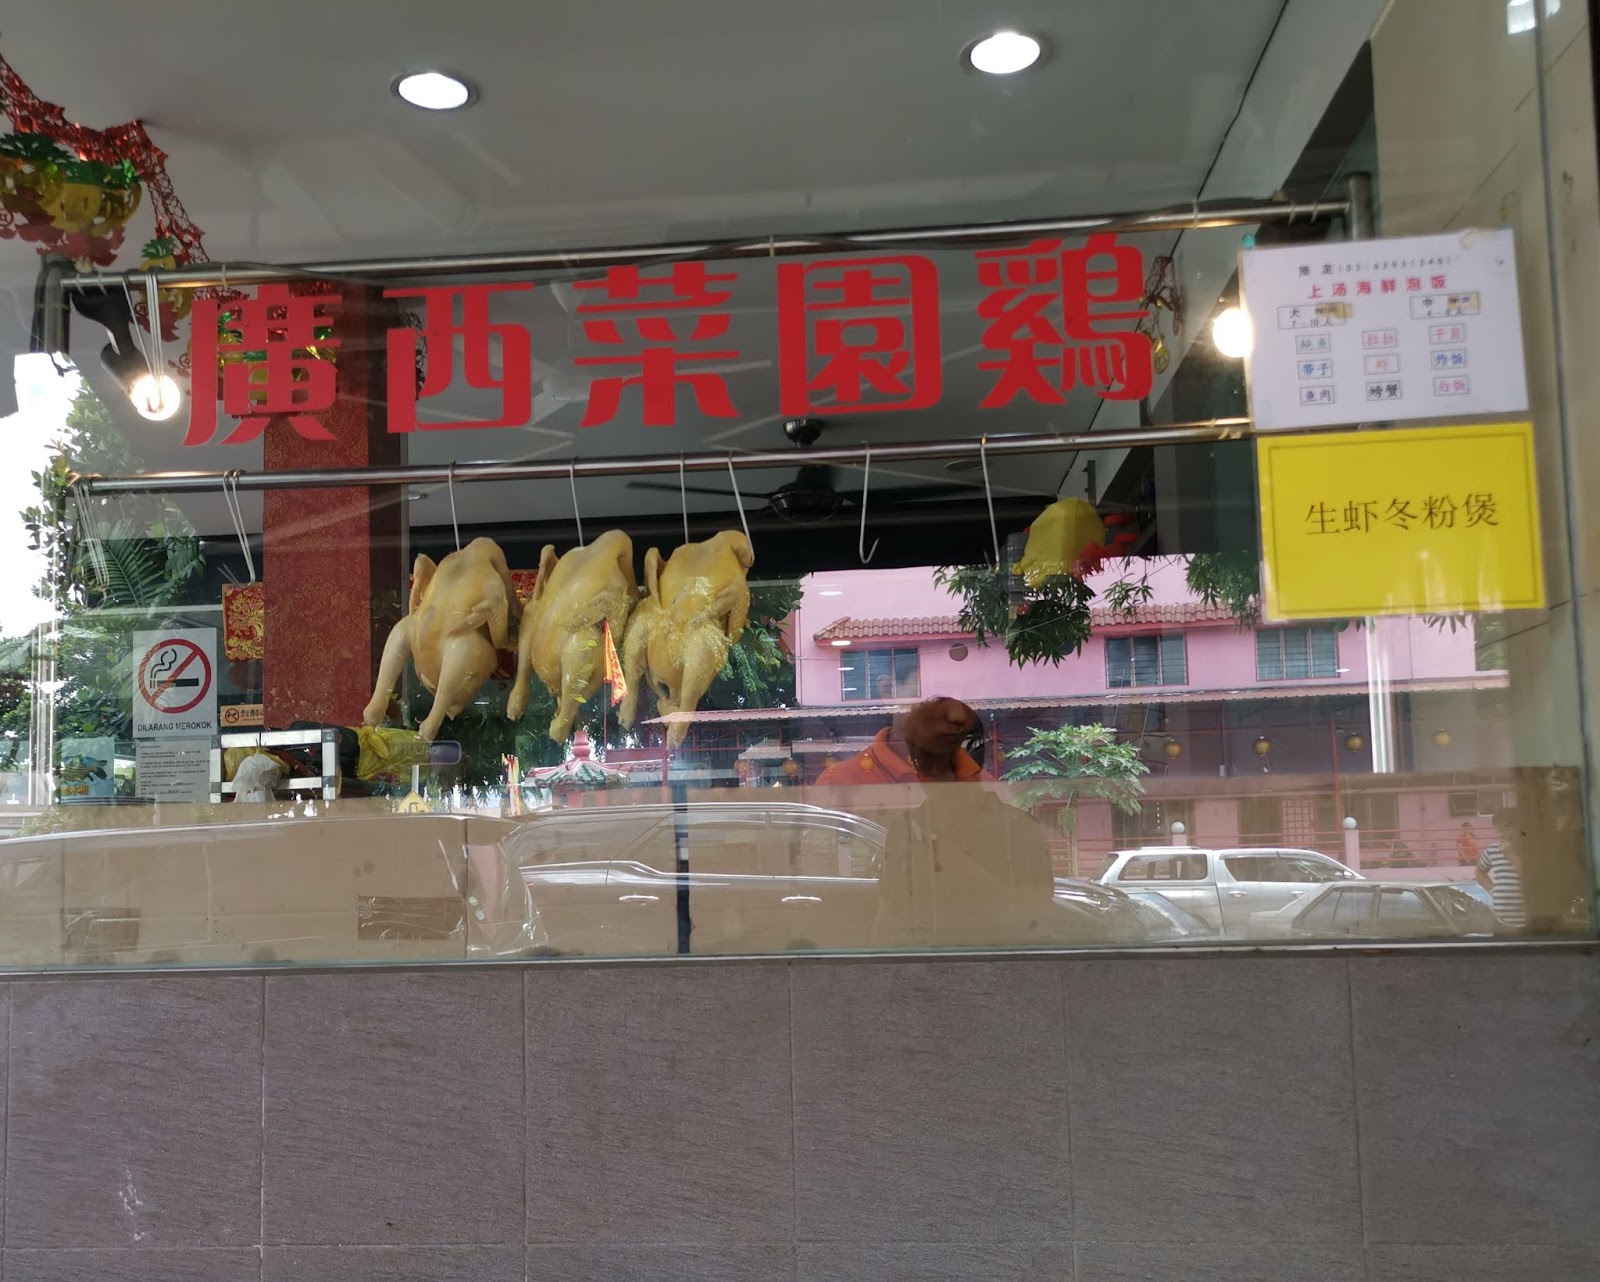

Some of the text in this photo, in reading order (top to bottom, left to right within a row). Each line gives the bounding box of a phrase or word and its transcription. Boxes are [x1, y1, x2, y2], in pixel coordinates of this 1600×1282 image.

[1308, 274, 1448, 299] 上汤海鲜泡饭
[1368, 383, 1399, 399] 螃蟹
[1304, 492, 1499, 535] 生虾冬粉煲
[137, 721, 212, 732] DILARANG MEROKOK
